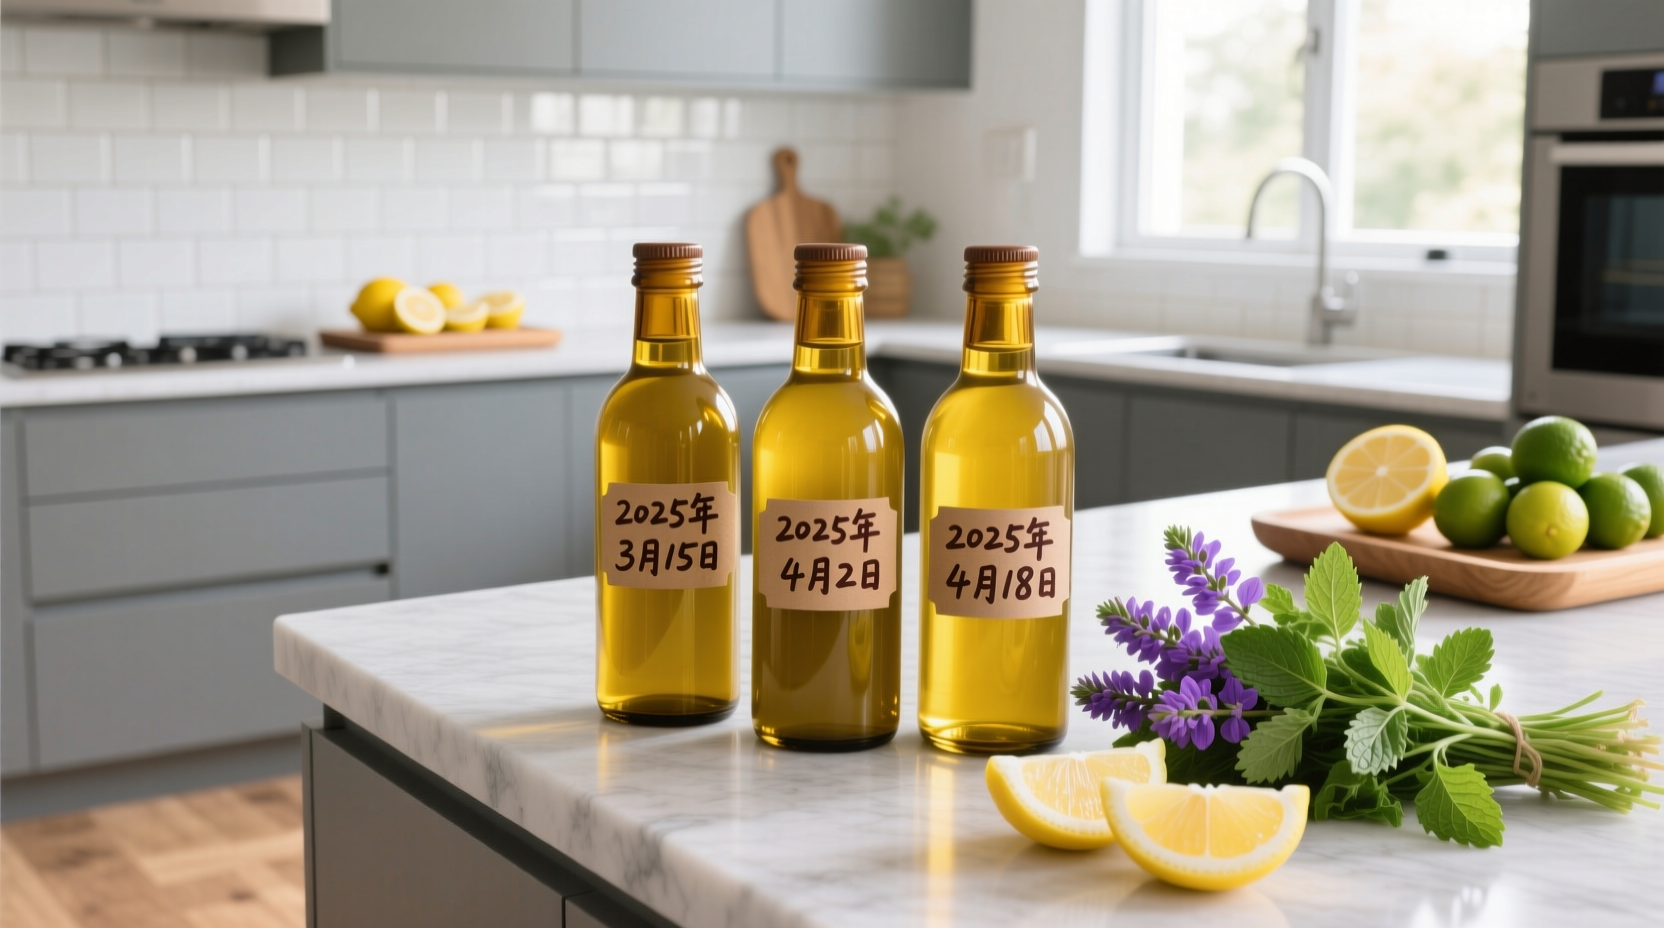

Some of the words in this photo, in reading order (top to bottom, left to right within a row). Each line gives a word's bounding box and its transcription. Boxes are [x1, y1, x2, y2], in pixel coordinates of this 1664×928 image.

[614, 491, 719, 536] 2025年
[774, 507, 881, 554] 2025年
[614, 537, 719, 578] 3月15日
[944, 516, 1054, 562] 2025年
[779, 556, 880, 596] 4月2日
[944, 563, 1056, 605] 4月18日
